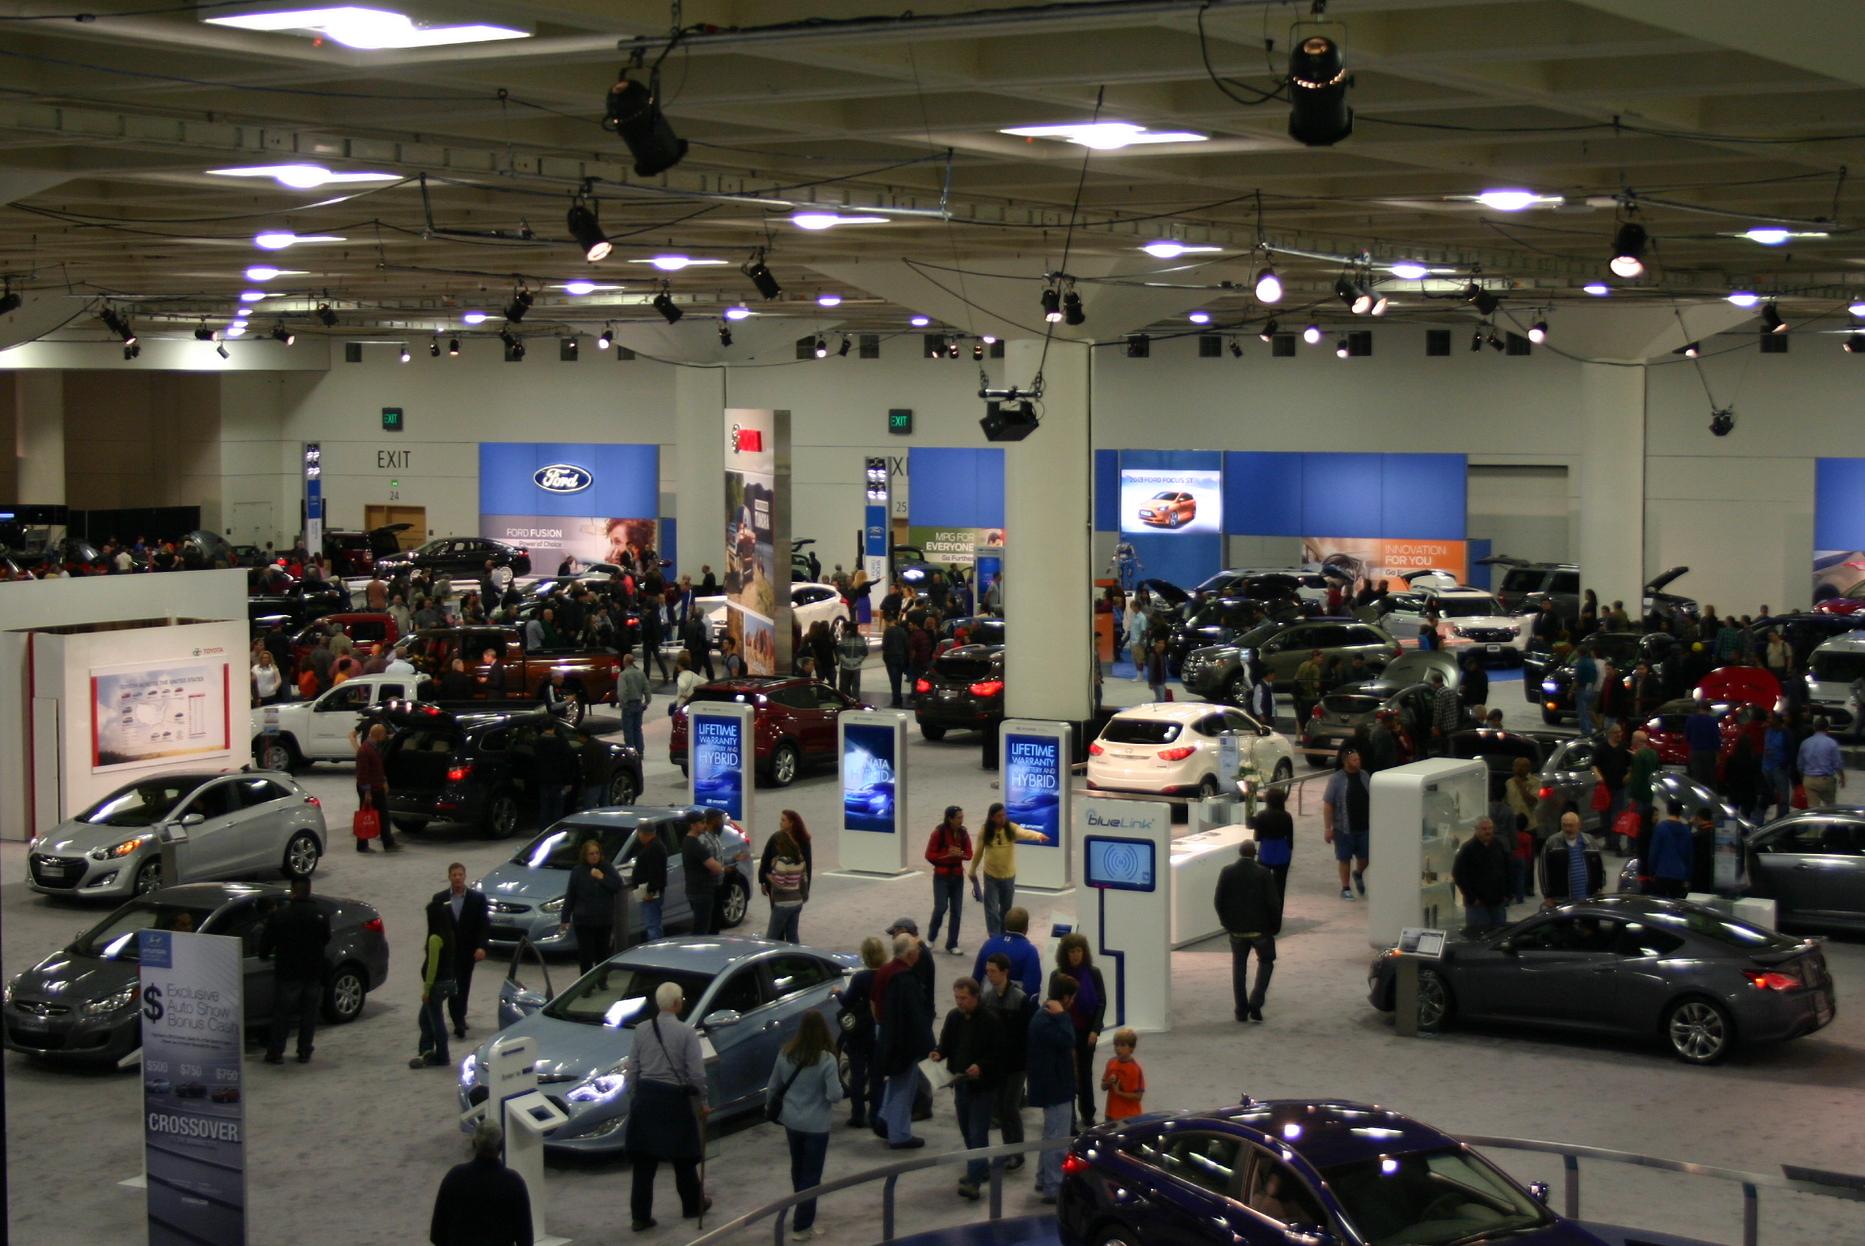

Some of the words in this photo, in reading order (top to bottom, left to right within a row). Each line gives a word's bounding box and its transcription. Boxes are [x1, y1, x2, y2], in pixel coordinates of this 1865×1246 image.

[384, 413, 398, 424] EXIT
[891, 415, 908, 427] EXIT
[377, 450, 411, 468] EXIT
[389, 490, 400, 501] 24
[896, 501, 907, 513] 25
[506, 528, 529, 538] FORD
[530, 528, 562, 538] FUSION
[935, 532, 955, 541] MPG
[956, 532, 975, 542] FOR
[926, 541, 975, 551] EVERYONE
[1384, 544, 1447, 555] INNOVATION
[1384, 555, 1407, 565] FOR
[1408, 556, 1432, 566] YOU
[203, 647, 224, 655] TOYOTA
[698, 723, 737, 737] LIFETIME
[699, 735, 738, 746] WARRANTY
[1011, 742, 1055, 757] LIFETIME
[698, 751, 739, 766] HYBRID
[1011, 755, 1055, 767] WARRANTY
[1011, 773, 1056, 788] HYBRID
[1087, 814, 1152, 829] blueLink
[167, 983, 219, 1002] Exclusive
[143, 982, 164, 1024] $
[167, 1000, 194, 1014] Auto
[196, 1001, 231, 1018] Show
[168, 1013, 205, 1030] Bonus
[207, 1016, 239, 1036] Cash
[180, 1063, 202, 1077] $750
[215, 1067, 239, 1081] $750
[149, 1112, 239, 1142] CROSSOVER
